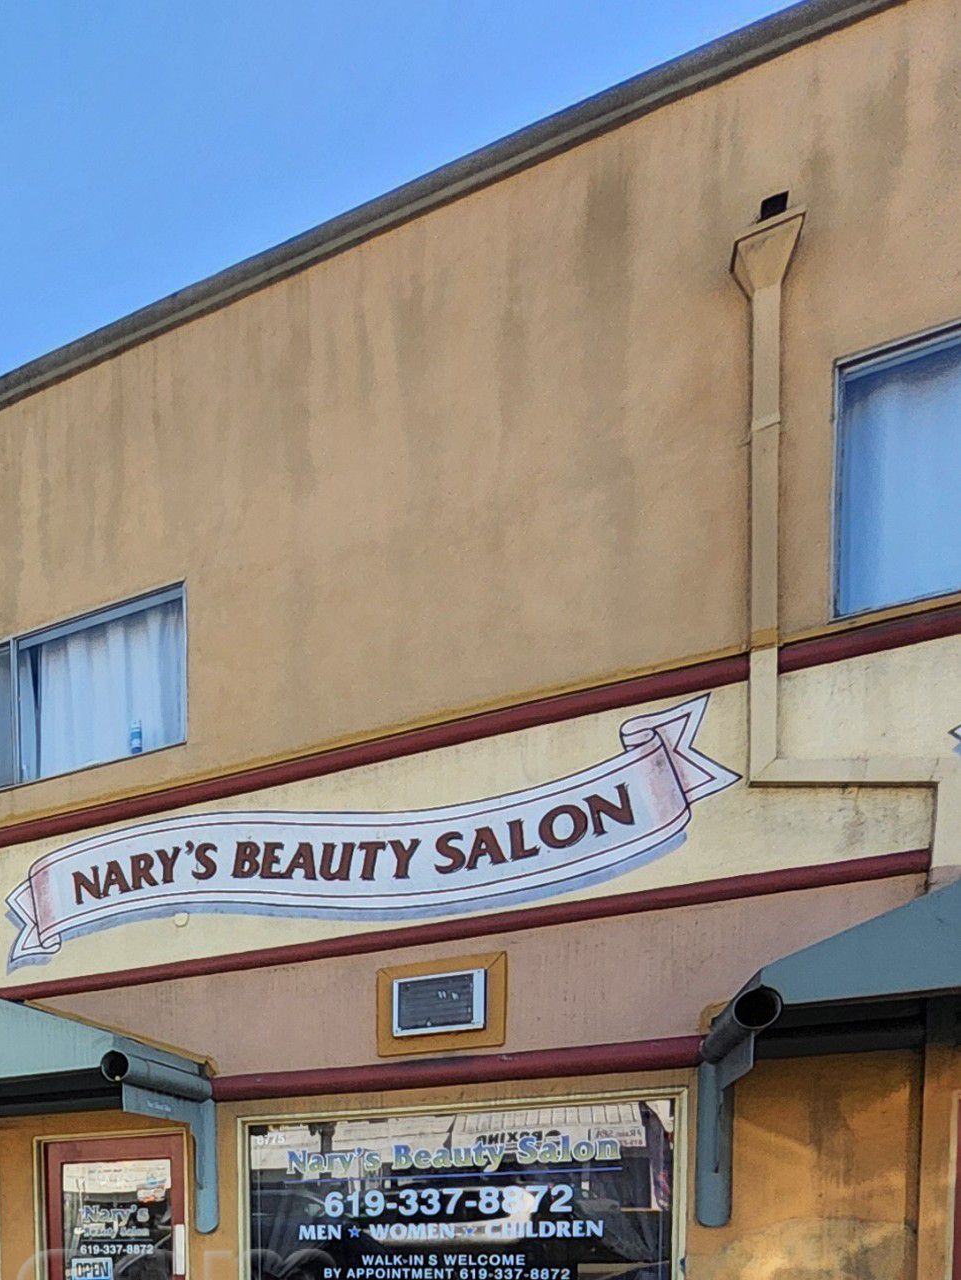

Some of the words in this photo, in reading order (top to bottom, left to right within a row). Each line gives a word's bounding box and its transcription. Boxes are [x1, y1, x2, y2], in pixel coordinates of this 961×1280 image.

[71, 840, 219, 905] NARY'S
[230, 836, 422, 882] BEAUTY
[434, 782, 636, 876] SALON
[287, 1147, 382, 1176] Nary's
[392, 1142, 505, 1173] Beauty
[517, 1134, 622, 1165] Salon
[324, 1183, 574, 1219] 619-337-8872
[82, 1203, 150, 1227] Nary's
[298, 1224, 342, 1241] MEN
[369, 1222, 456, 1241] WOMEN
[485, 1219, 604, 1239] CHILDREN
[80, 1244, 154, 1255] 619-337-8872
[361, 1254, 424, 1266] WALK-IN
[443, 1253, 526, 1266] WELCOME
[76, 1262, 110, 1278] OPEN
[324, 1268, 342, 1279] BY
[346, 1268, 454, 1280] APPOINTMENT
[459, 1268, 571, 1280] 619-337-8872
